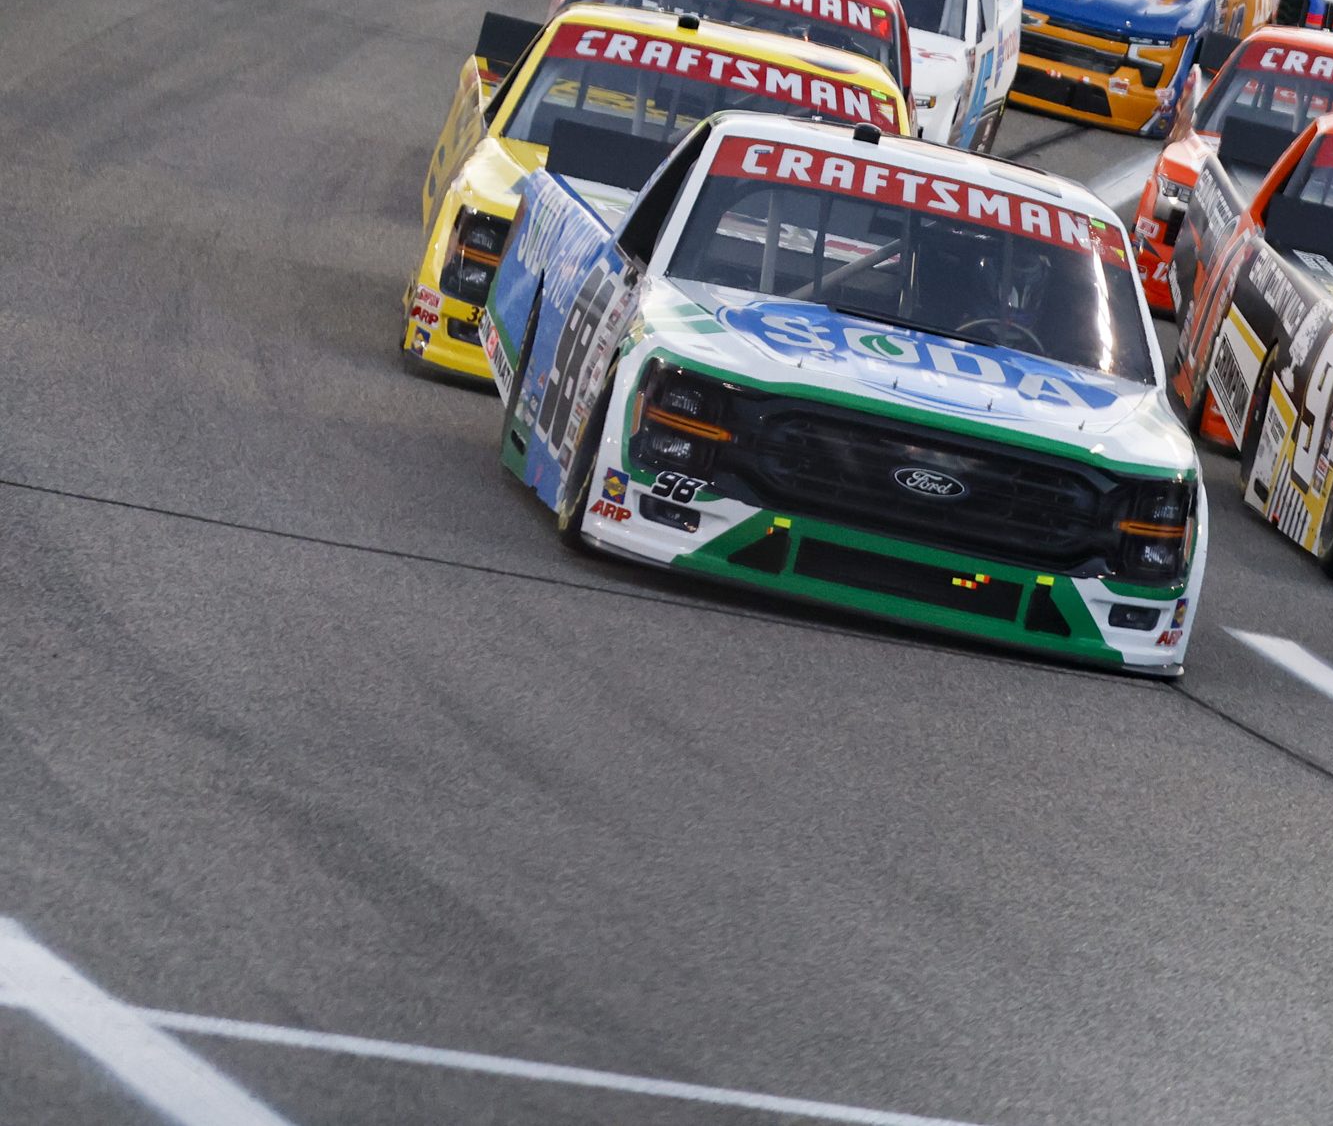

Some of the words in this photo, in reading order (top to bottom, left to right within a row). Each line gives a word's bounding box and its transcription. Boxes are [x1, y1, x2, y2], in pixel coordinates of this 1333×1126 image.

[574, 29, 871, 121] CRAFTSMAN
[741, 143, 1091, 251] CRAFTSMAN
[411, 305, 439, 325] ARP
[760, 312, 1093, 410] SODA
[651, 471, 707, 505] 98
[905, 469, 953, 497] Ford
[589, 498, 632, 523] ARP
